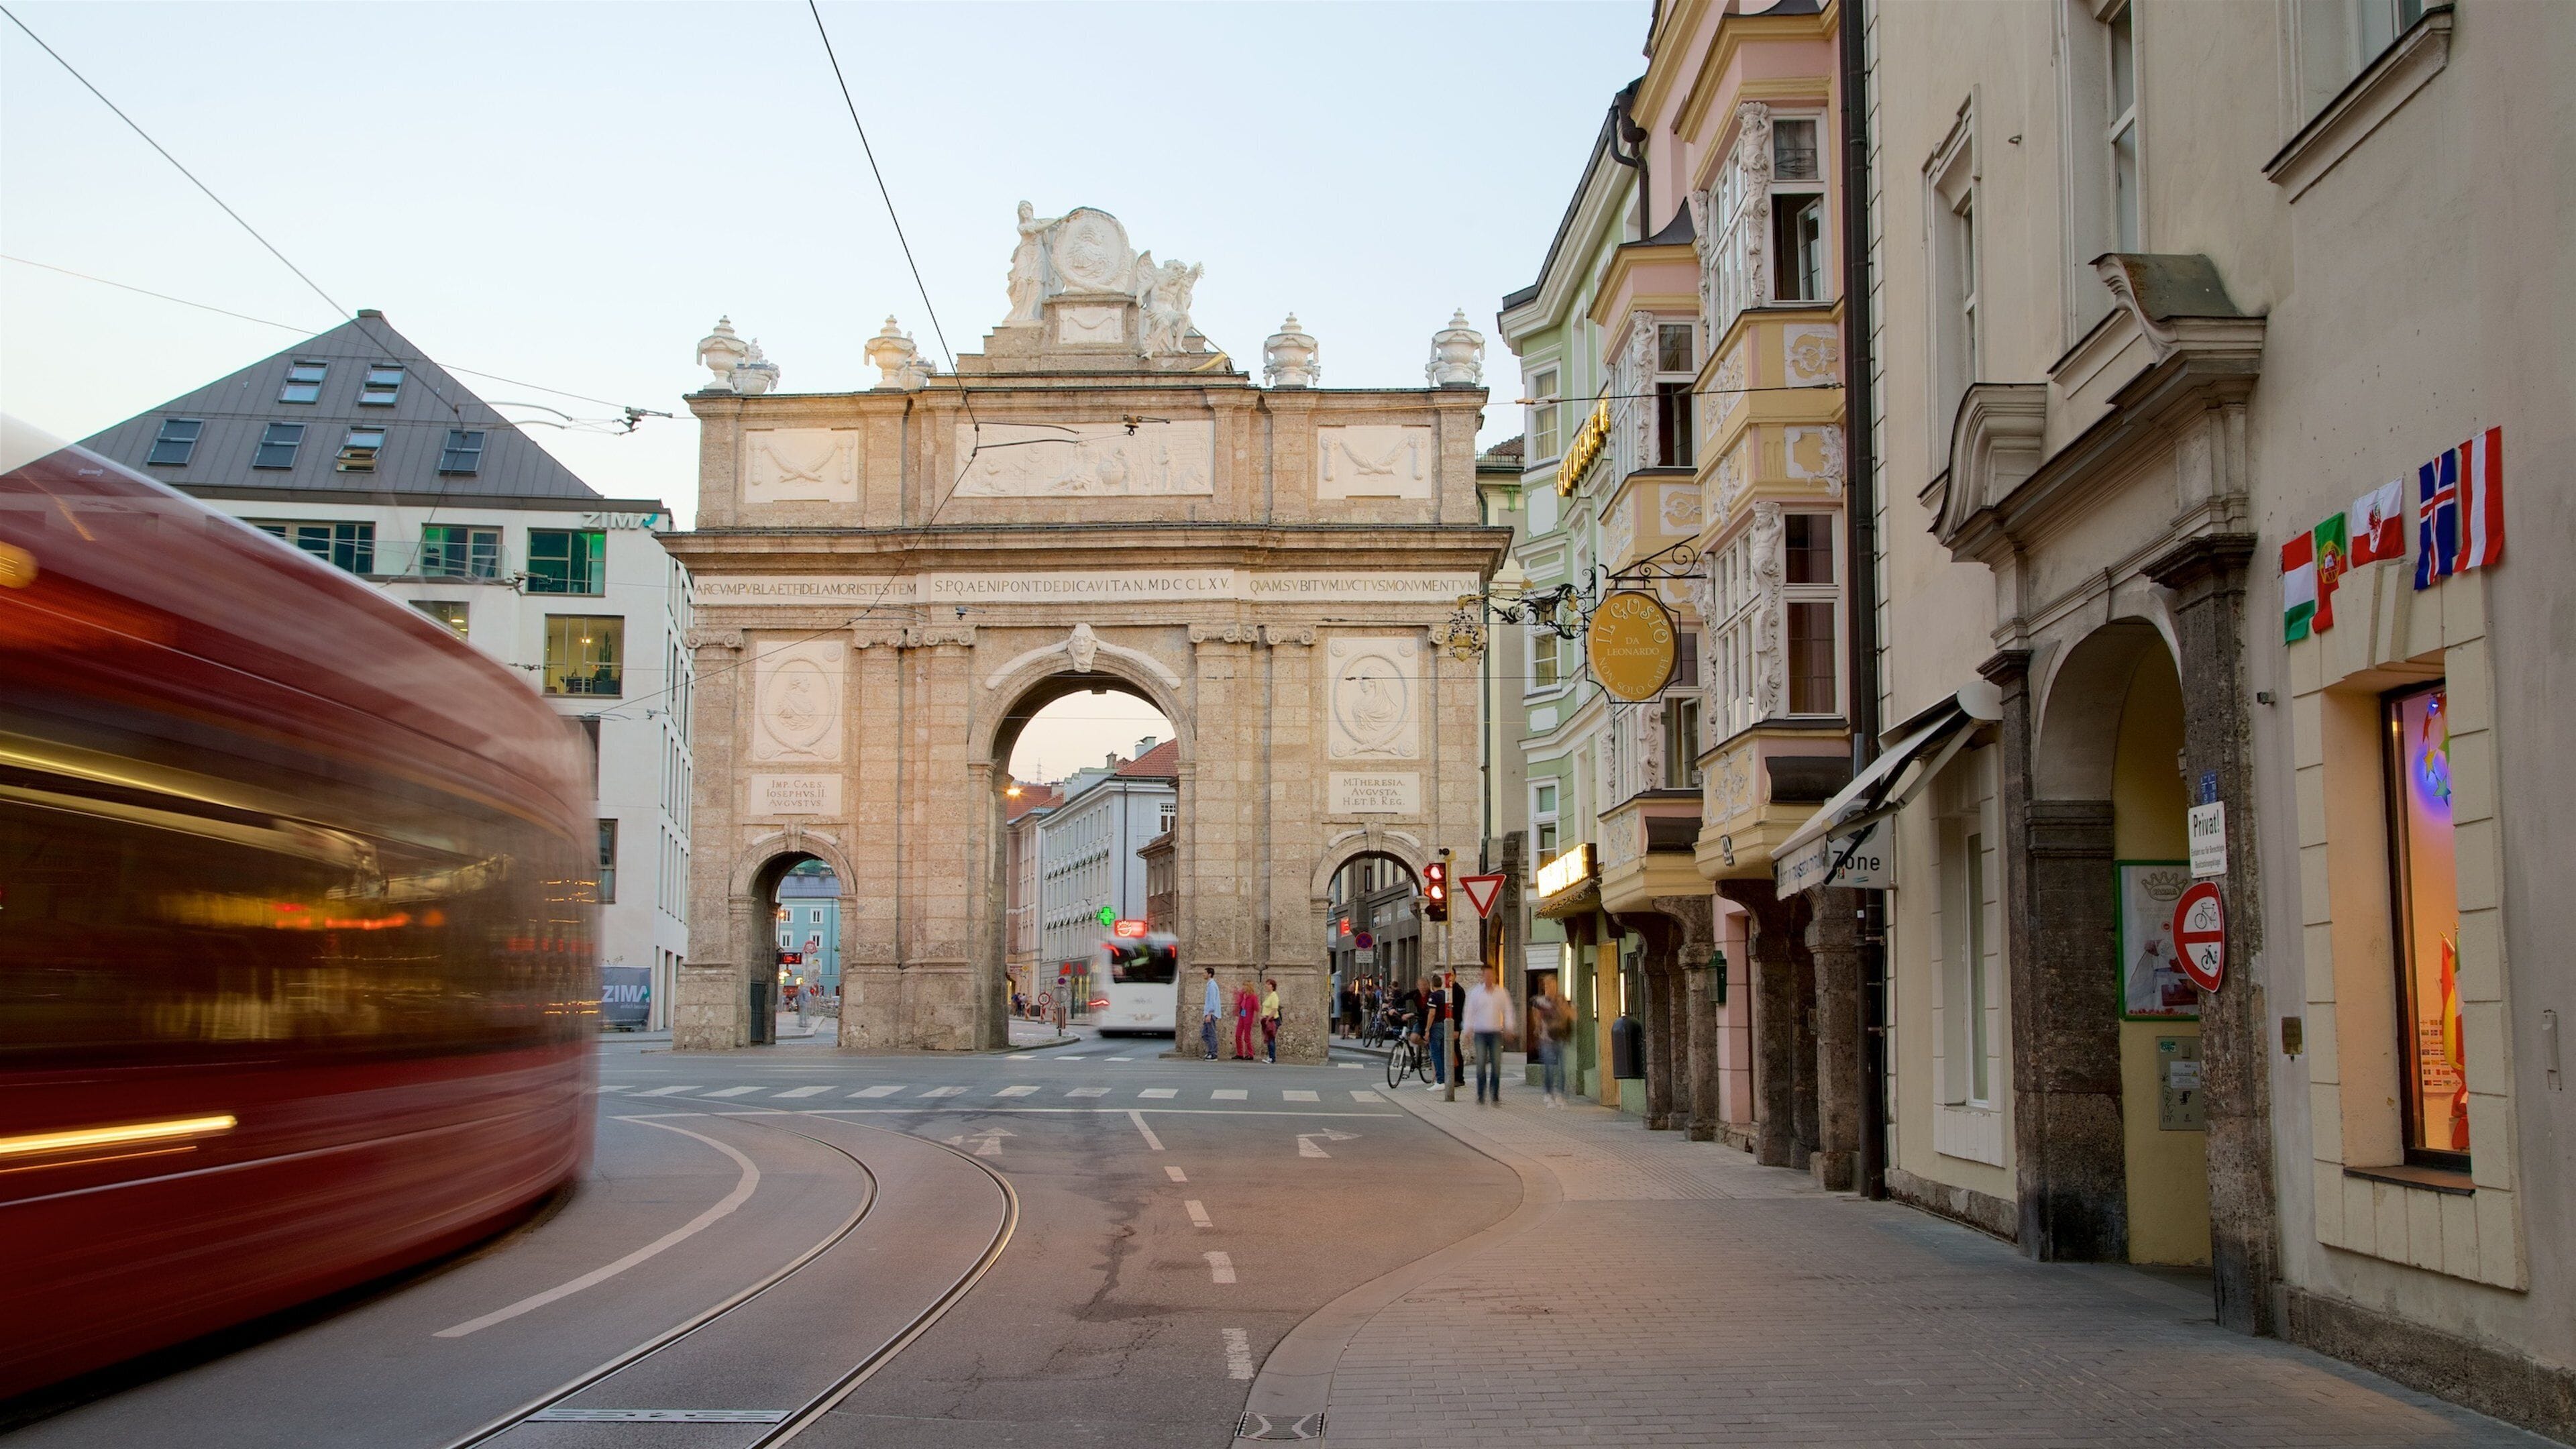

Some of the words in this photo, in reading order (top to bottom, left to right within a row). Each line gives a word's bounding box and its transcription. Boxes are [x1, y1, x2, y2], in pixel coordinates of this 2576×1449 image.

[582, 511, 659, 530] ZIMA
[1595, 625, 1615, 644] IL
[1610, 598, 1669, 644] GUSTO
[1625, 637, 1640, 645] DA
[1607, 647, 1660, 656] LEONARDO
[1598, 656, 1615, 683] NON
[1617, 682, 1645, 694] SOLO
[2193, 808, 2220, 838] Privat!
[1833, 850, 1880, 871] Zone
[601, 985, 651, 1003] ZIMA
